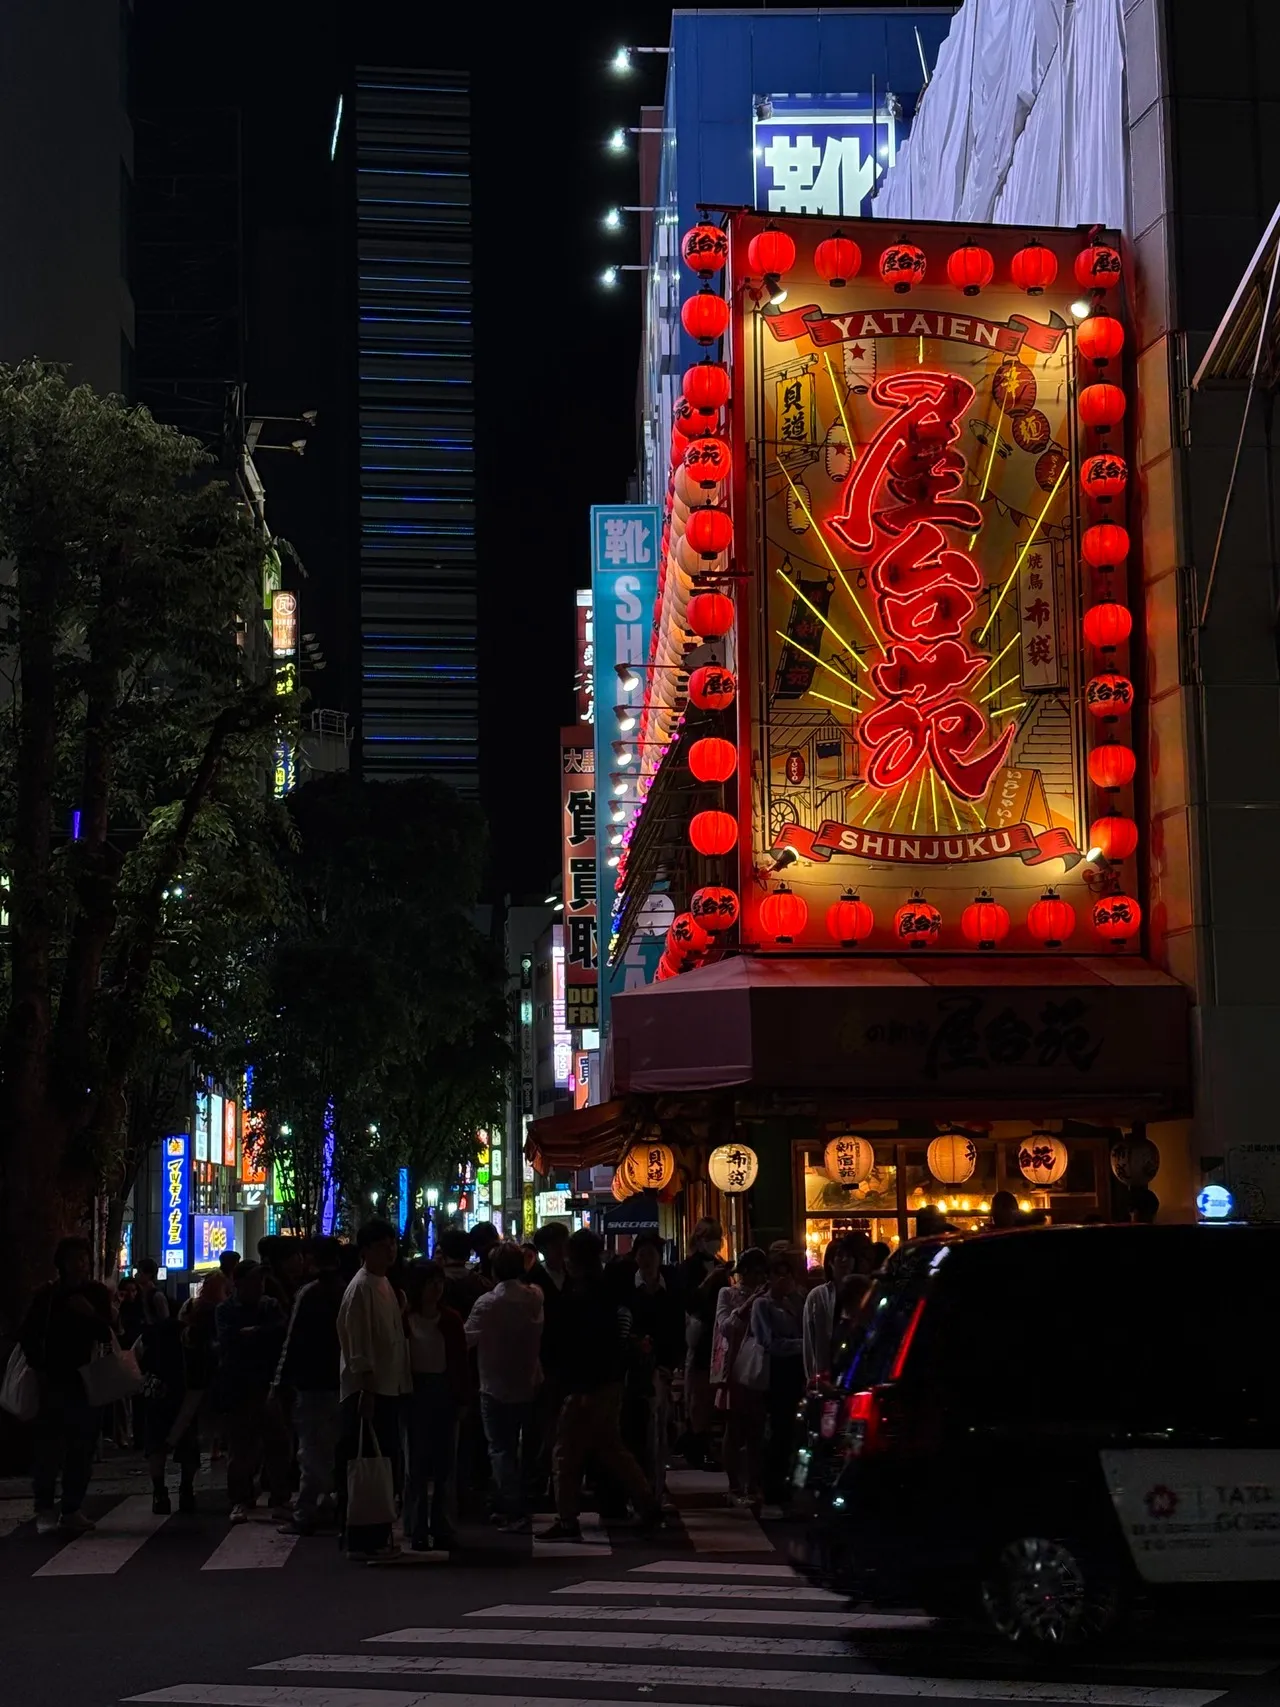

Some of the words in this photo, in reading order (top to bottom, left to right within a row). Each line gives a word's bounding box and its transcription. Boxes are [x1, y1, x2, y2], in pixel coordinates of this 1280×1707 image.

[831, 313, 999, 347] YATAIEN
[781, 381, 808, 441] 貝道
[685, 444, 723, 465] 台苑
[604, 519, 650, 564] 靴
[825, 371, 1016, 802] 屋台苑
[1026, 553, 1043, 591] 焼鳥
[1022, 597, 1054, 667] 布袋
[790, 757, 799, 780] TOKYO
[838, 830, 1012, 859] SHINJUKU
[1093, 903, 1133, 927] 台苑
[726, 1150, 747, 1187] 布袋
[836, 1142, 856, 1178] 新宿苑
[1019, 1146, 1057, 1171] 台苑
[607, 1221, 660, 1229] SKECHER
